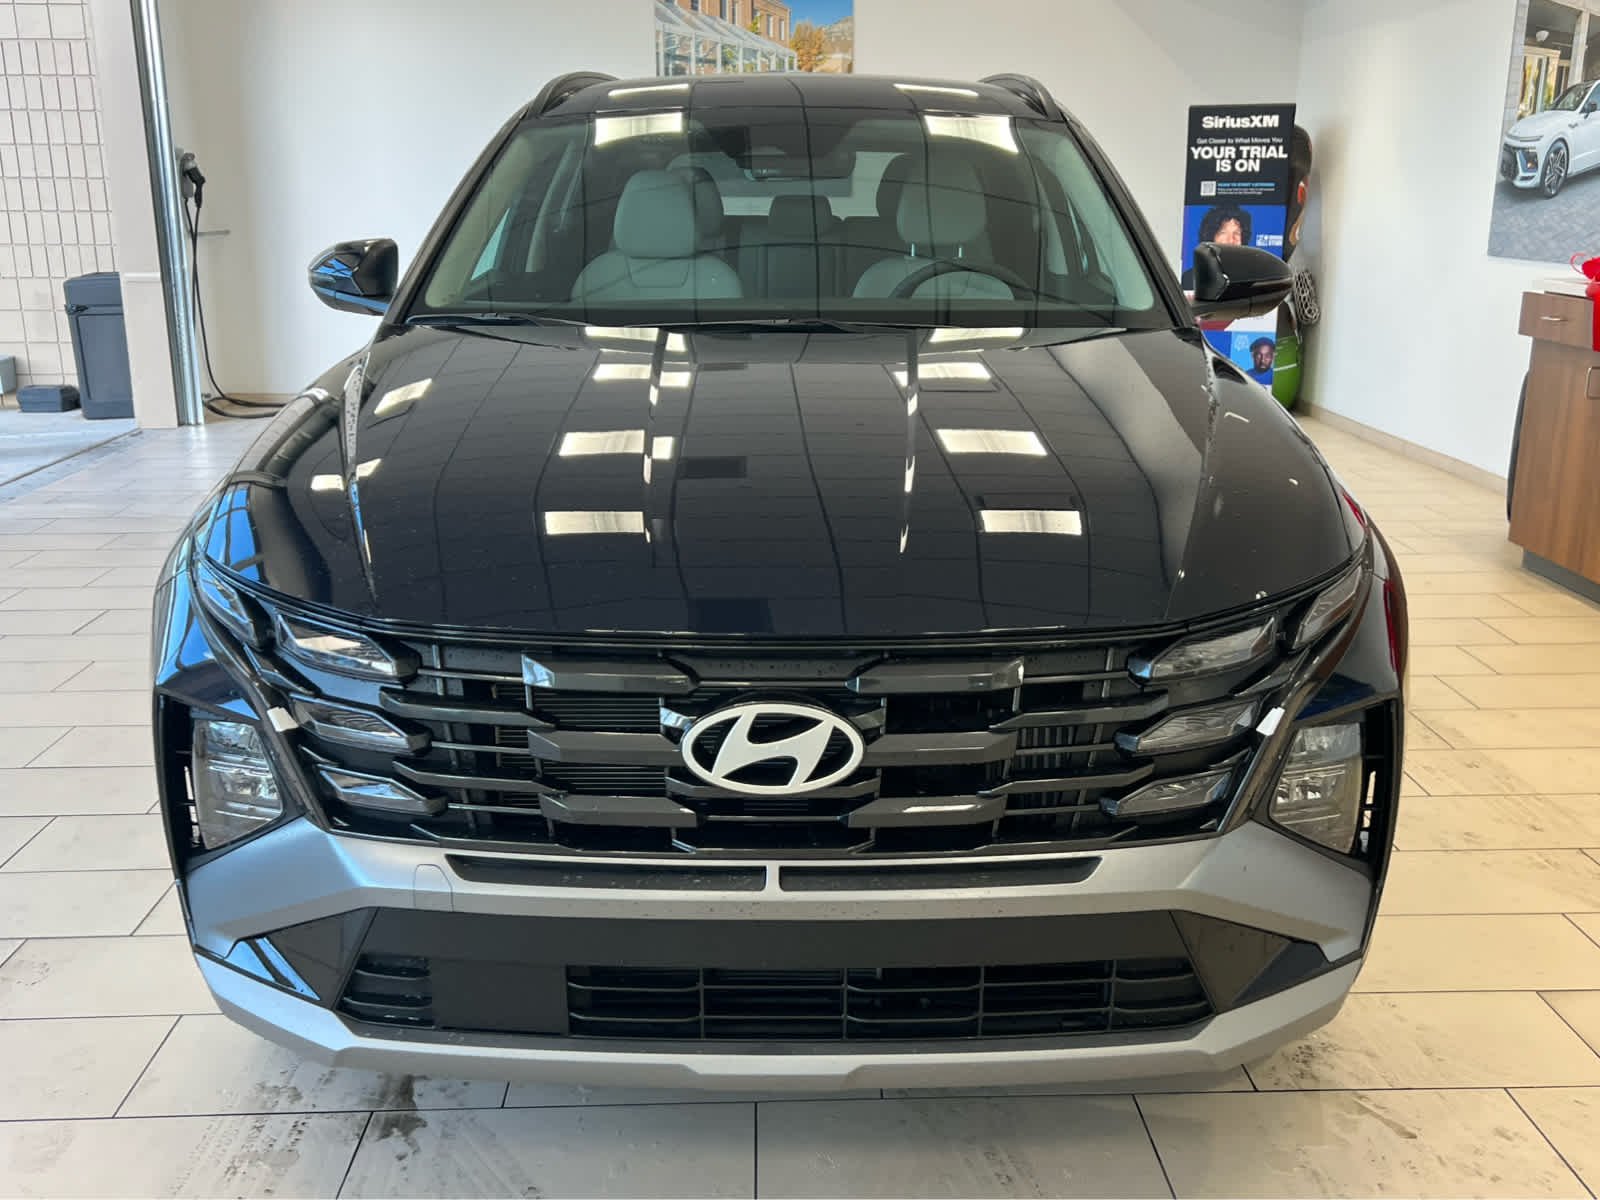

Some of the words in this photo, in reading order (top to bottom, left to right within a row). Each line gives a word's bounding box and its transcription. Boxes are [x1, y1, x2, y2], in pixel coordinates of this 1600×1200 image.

[1202, 114, 1280, 129] SiriusXM
[1272, 136, 1283, 144] You
[1190, 146, 1236, 160] YOUR
[1240, 145, 1288, 159] TRIAL
[1216, 159, 1232, 172] IS
[1234, 159, 1260, 172] ON
